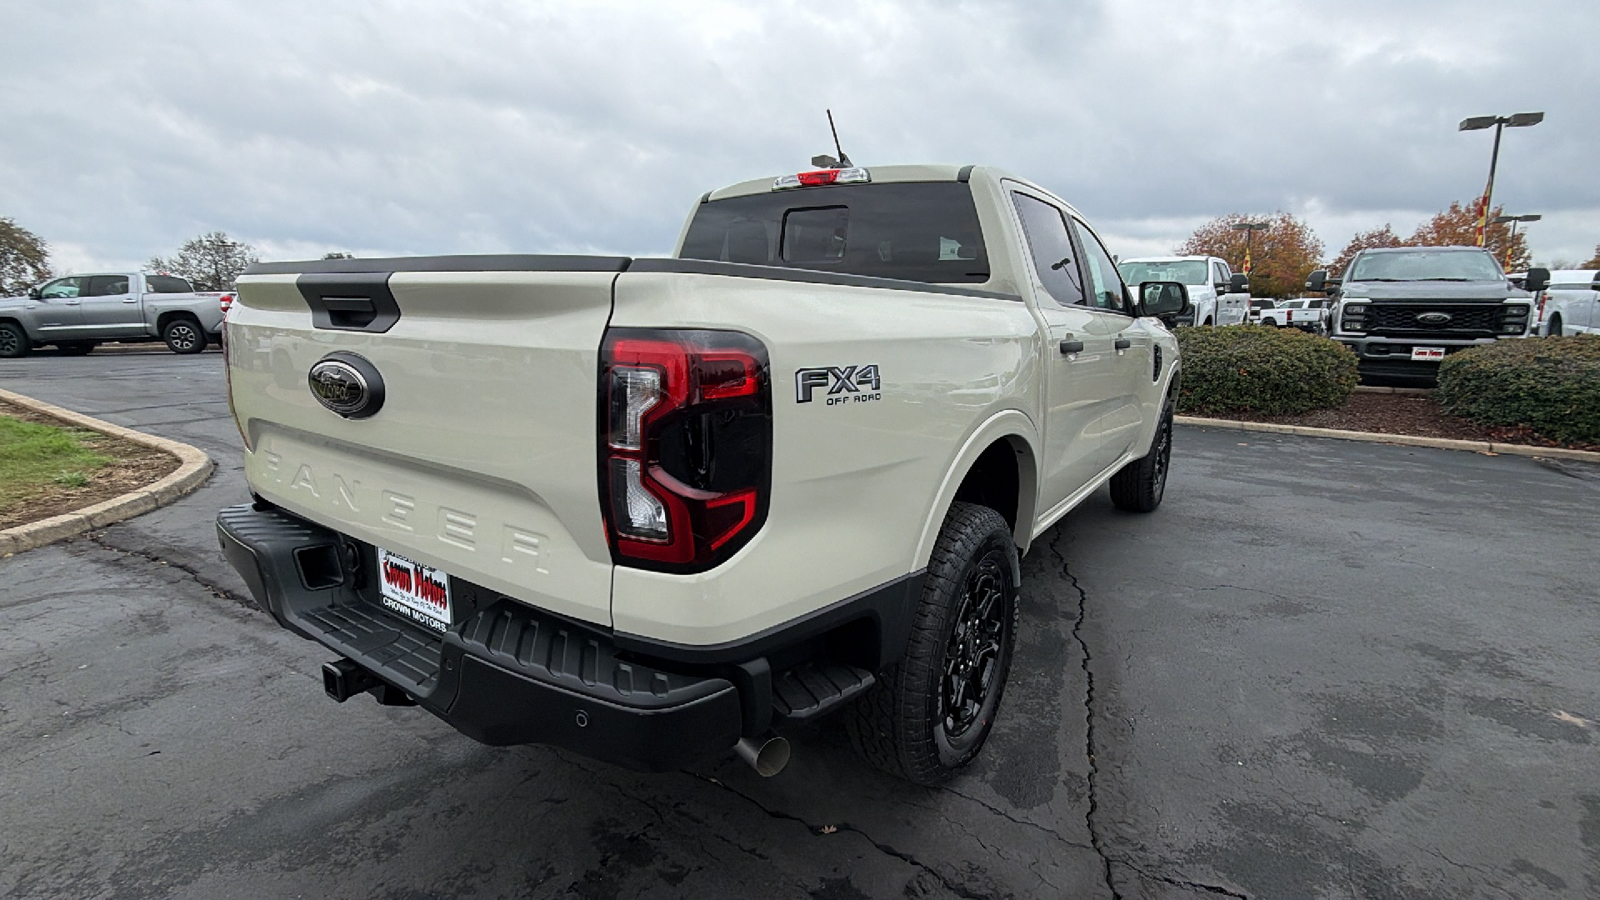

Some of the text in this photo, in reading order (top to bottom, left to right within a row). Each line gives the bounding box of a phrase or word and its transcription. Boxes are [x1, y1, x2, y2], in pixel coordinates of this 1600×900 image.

[795, 365, 880, 403] FX4
[826, 393, 882, 406] OFF ROAD
[263, 448, 549, 576] RANGER
[382, 559, 412, 594] Crown
[382, 597, 411, 617] CROWN
[412, 610, 447, 633] MOTORS
